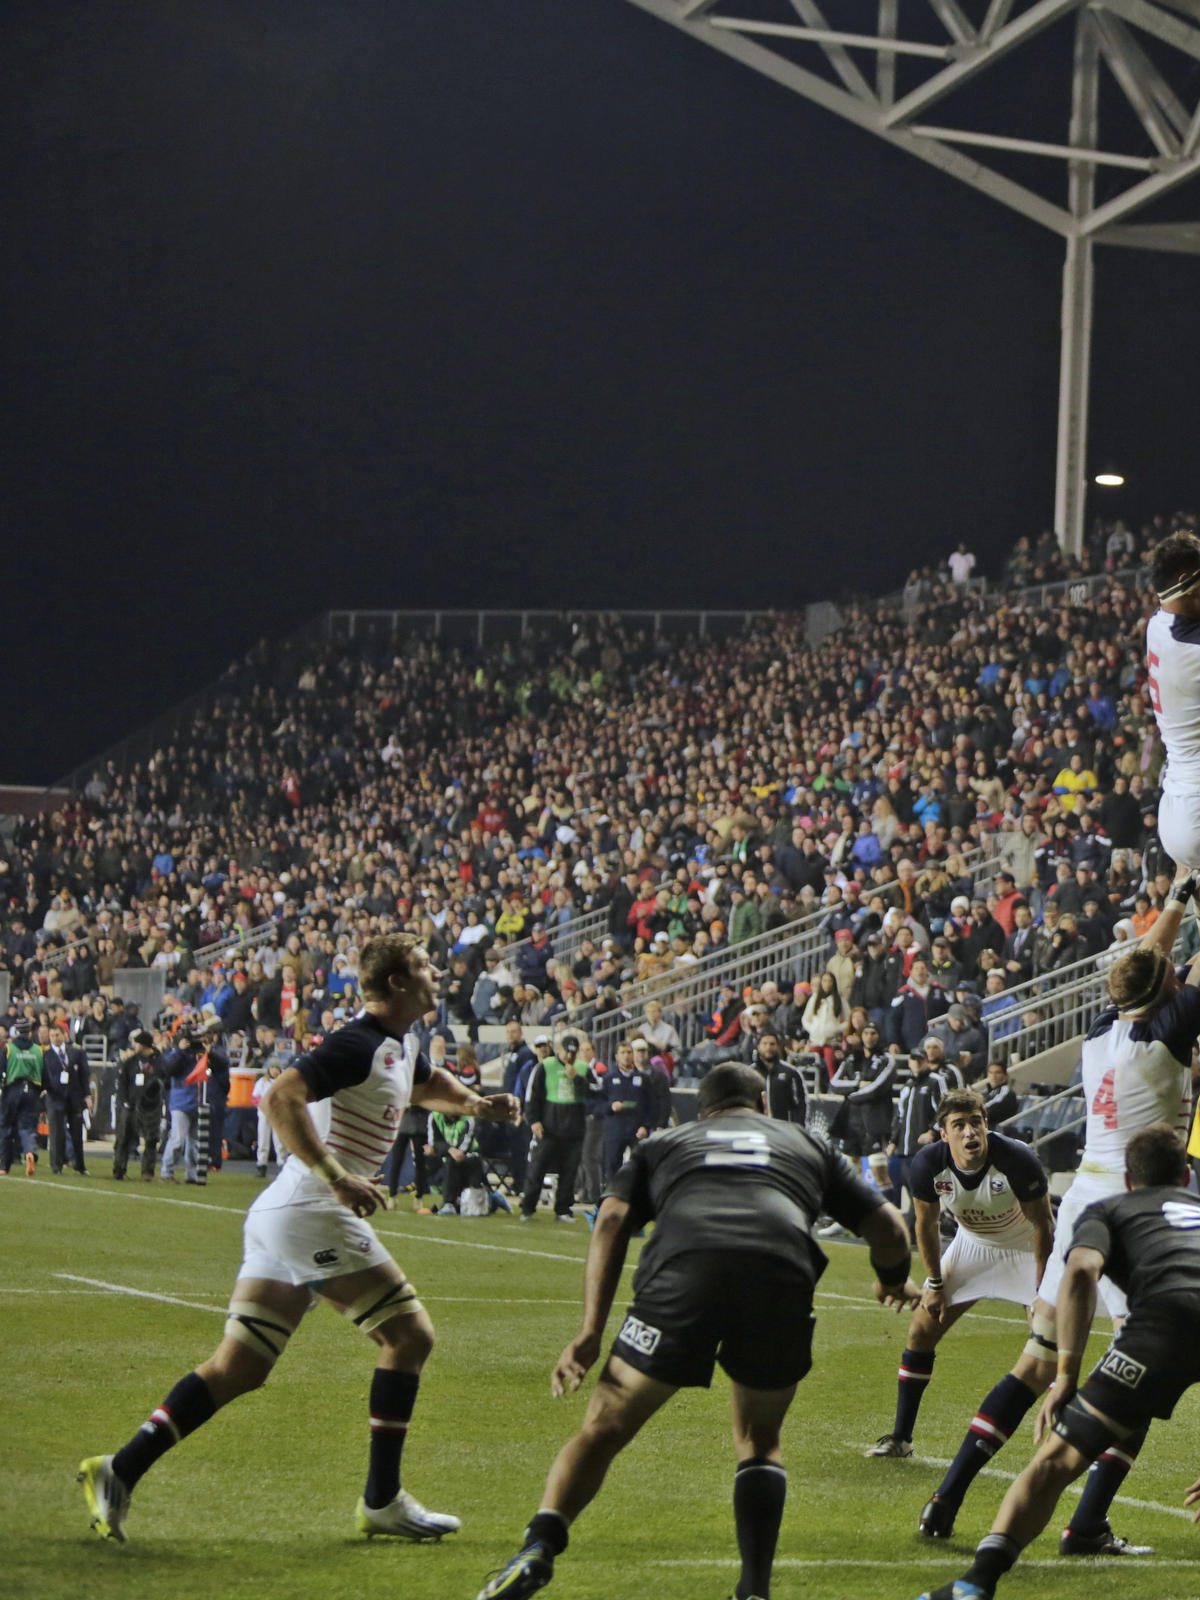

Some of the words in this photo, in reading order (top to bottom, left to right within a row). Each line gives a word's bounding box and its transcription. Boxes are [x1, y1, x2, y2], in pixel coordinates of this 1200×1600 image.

[1092, 1068, 1118, 1130] 4
[623, 1323, 653, 1348] AIG
[1106, 1356, 1139, 1380] AIG
